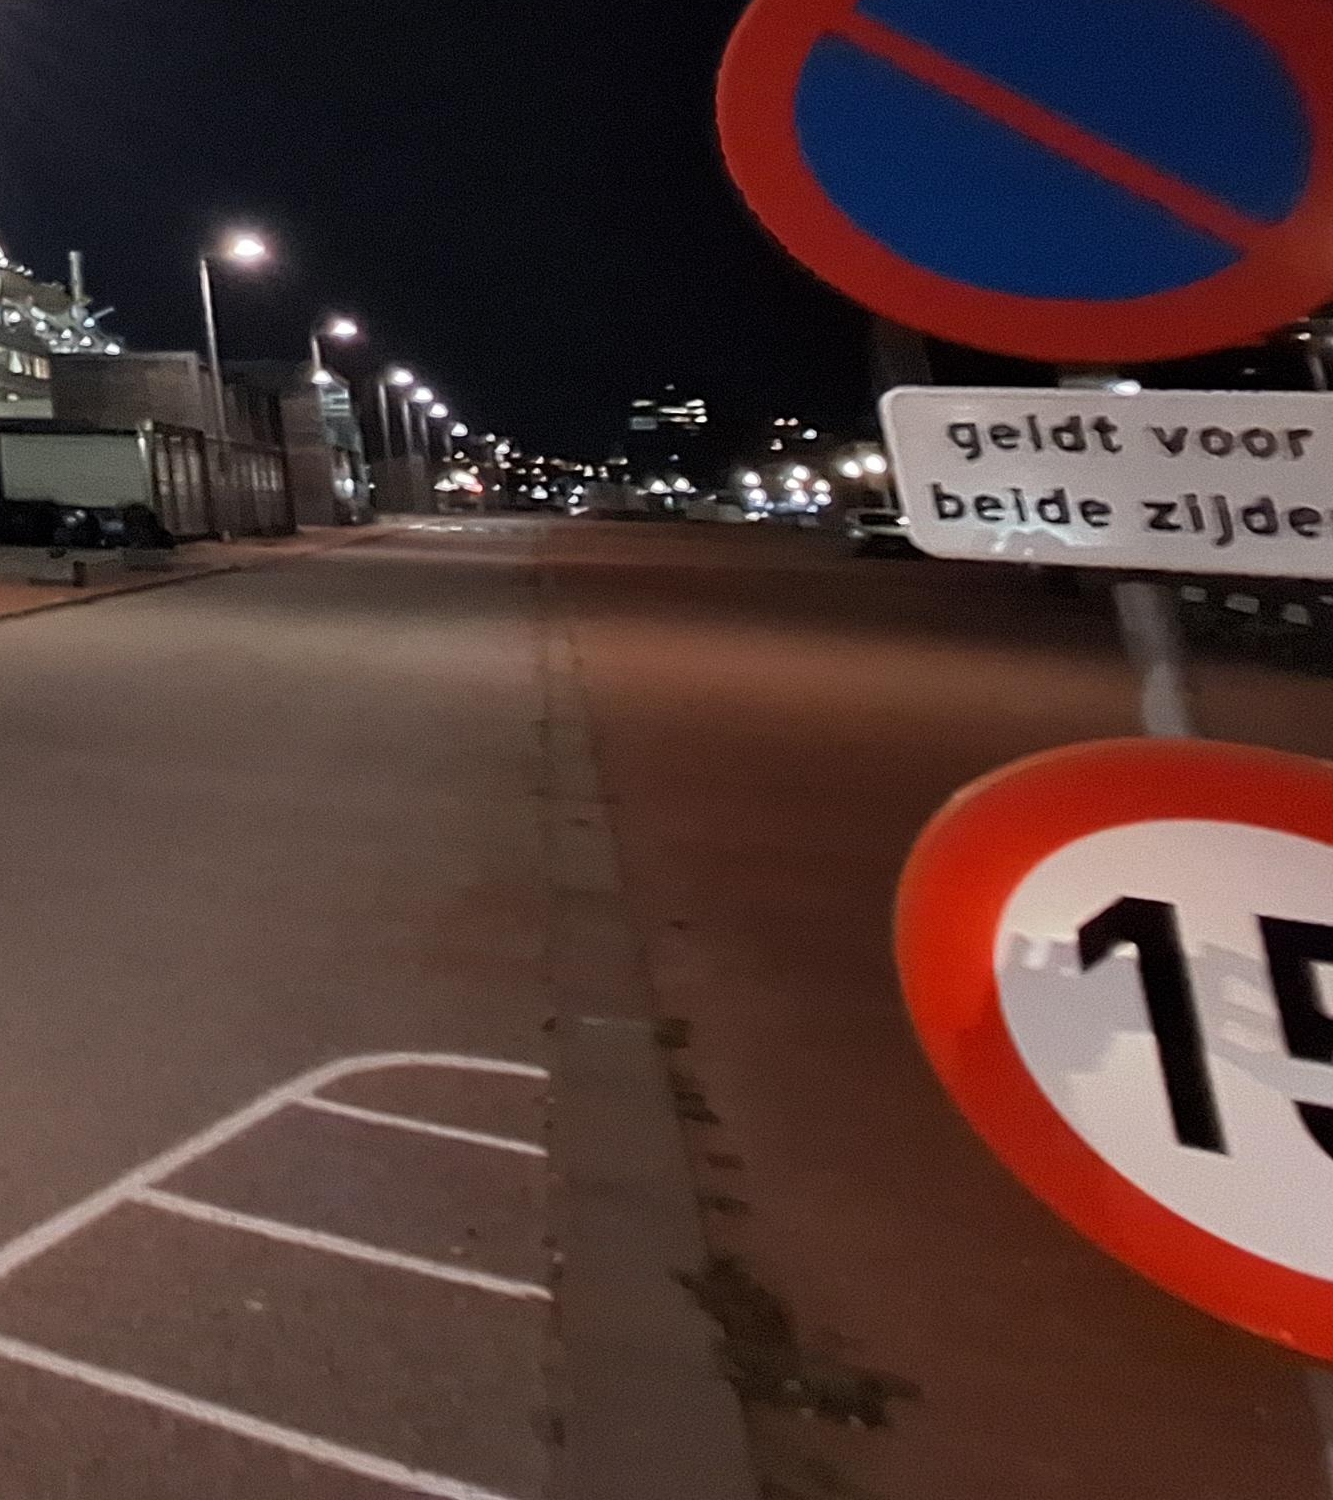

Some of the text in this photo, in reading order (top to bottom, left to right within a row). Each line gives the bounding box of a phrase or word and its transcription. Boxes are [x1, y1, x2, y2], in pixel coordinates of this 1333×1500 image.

[947, 414, 1314, 461] geldt voor
[930, 483, 1333, 546] beide zijde
